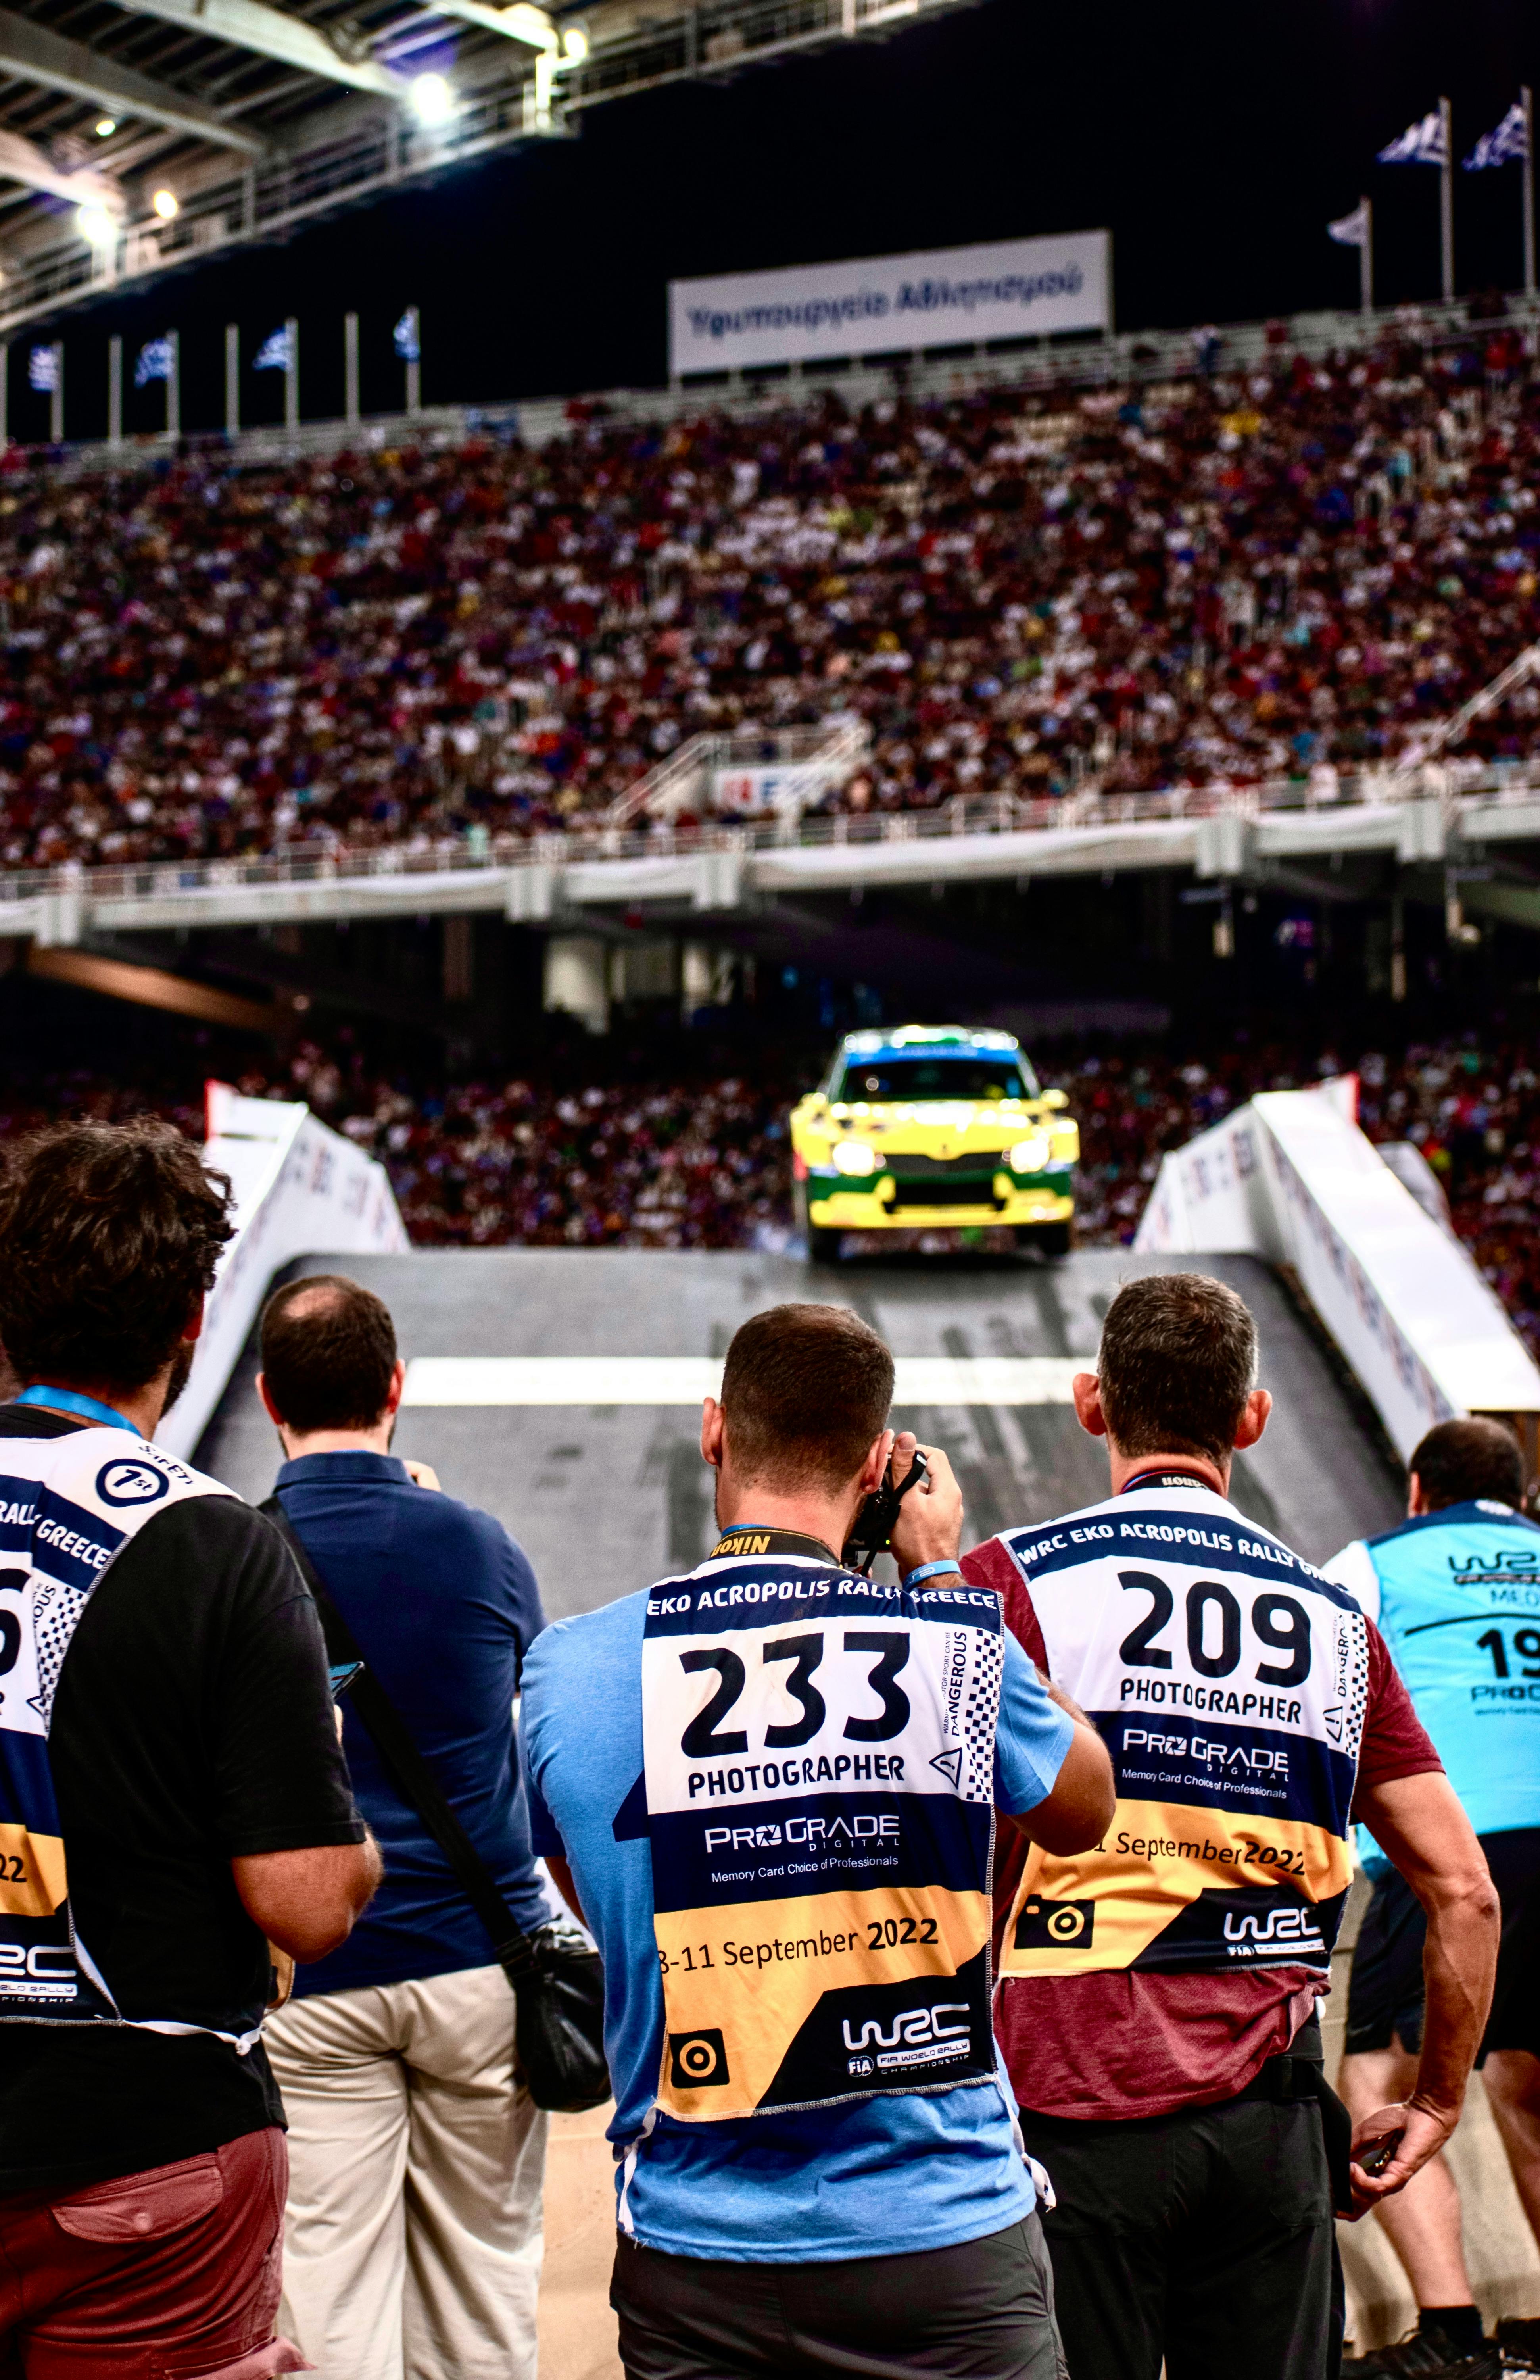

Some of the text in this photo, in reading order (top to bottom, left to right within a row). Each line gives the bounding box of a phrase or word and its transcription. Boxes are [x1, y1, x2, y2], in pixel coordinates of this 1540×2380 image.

[113, 1469, 153, 1491] 1st
[0, 1500, 111, 1570] RALL GREECE
[710, 1536, 771, 1557] Nikon
[1017, 1523, 1294, 1568] WRC EKO ACROPOLIS RALLY
[647, 1595, 690, 1616] EKO
[697, 1579, 831, 1611] ACROPOLIS
[910, 1590, 997, 1609] GREECE
[1117, 1570, 1311, 1688] 209
[678, 1632, 911, 1759] 233
[948, 1632, 967, 1737] DANGEROUS
[1120, 1678, 1301, 1724] PHOTOGRAPHER
[688, 1754, 904, 1798] PHOTOGRAPHER
[1122, 1769, 1287, 1799] Memory Card Choice of Professionals
[1207, 1764, 1288, 1782] DIGITAL
[809, 1840, 899, 1851] DIGITAL
[1116, 1832, 1242, 1865] September
[1244, 1841, 1305, 1875] 2022
[0, 1853, 27, 1883] 22
[712, 1856, 899, 1883] Memory Card Choice of Professionals
[724, 1929, 858, 1969] September
[868, 1917, 939, 1950] 2022
[843, 2004, 971, 2050] WRC
[881, 2054, 969, 2074] CHAMPIONSHIP
[901, 2049, 935, 2061] WORLD
[937, 2042, 968, 2054] RALLY
